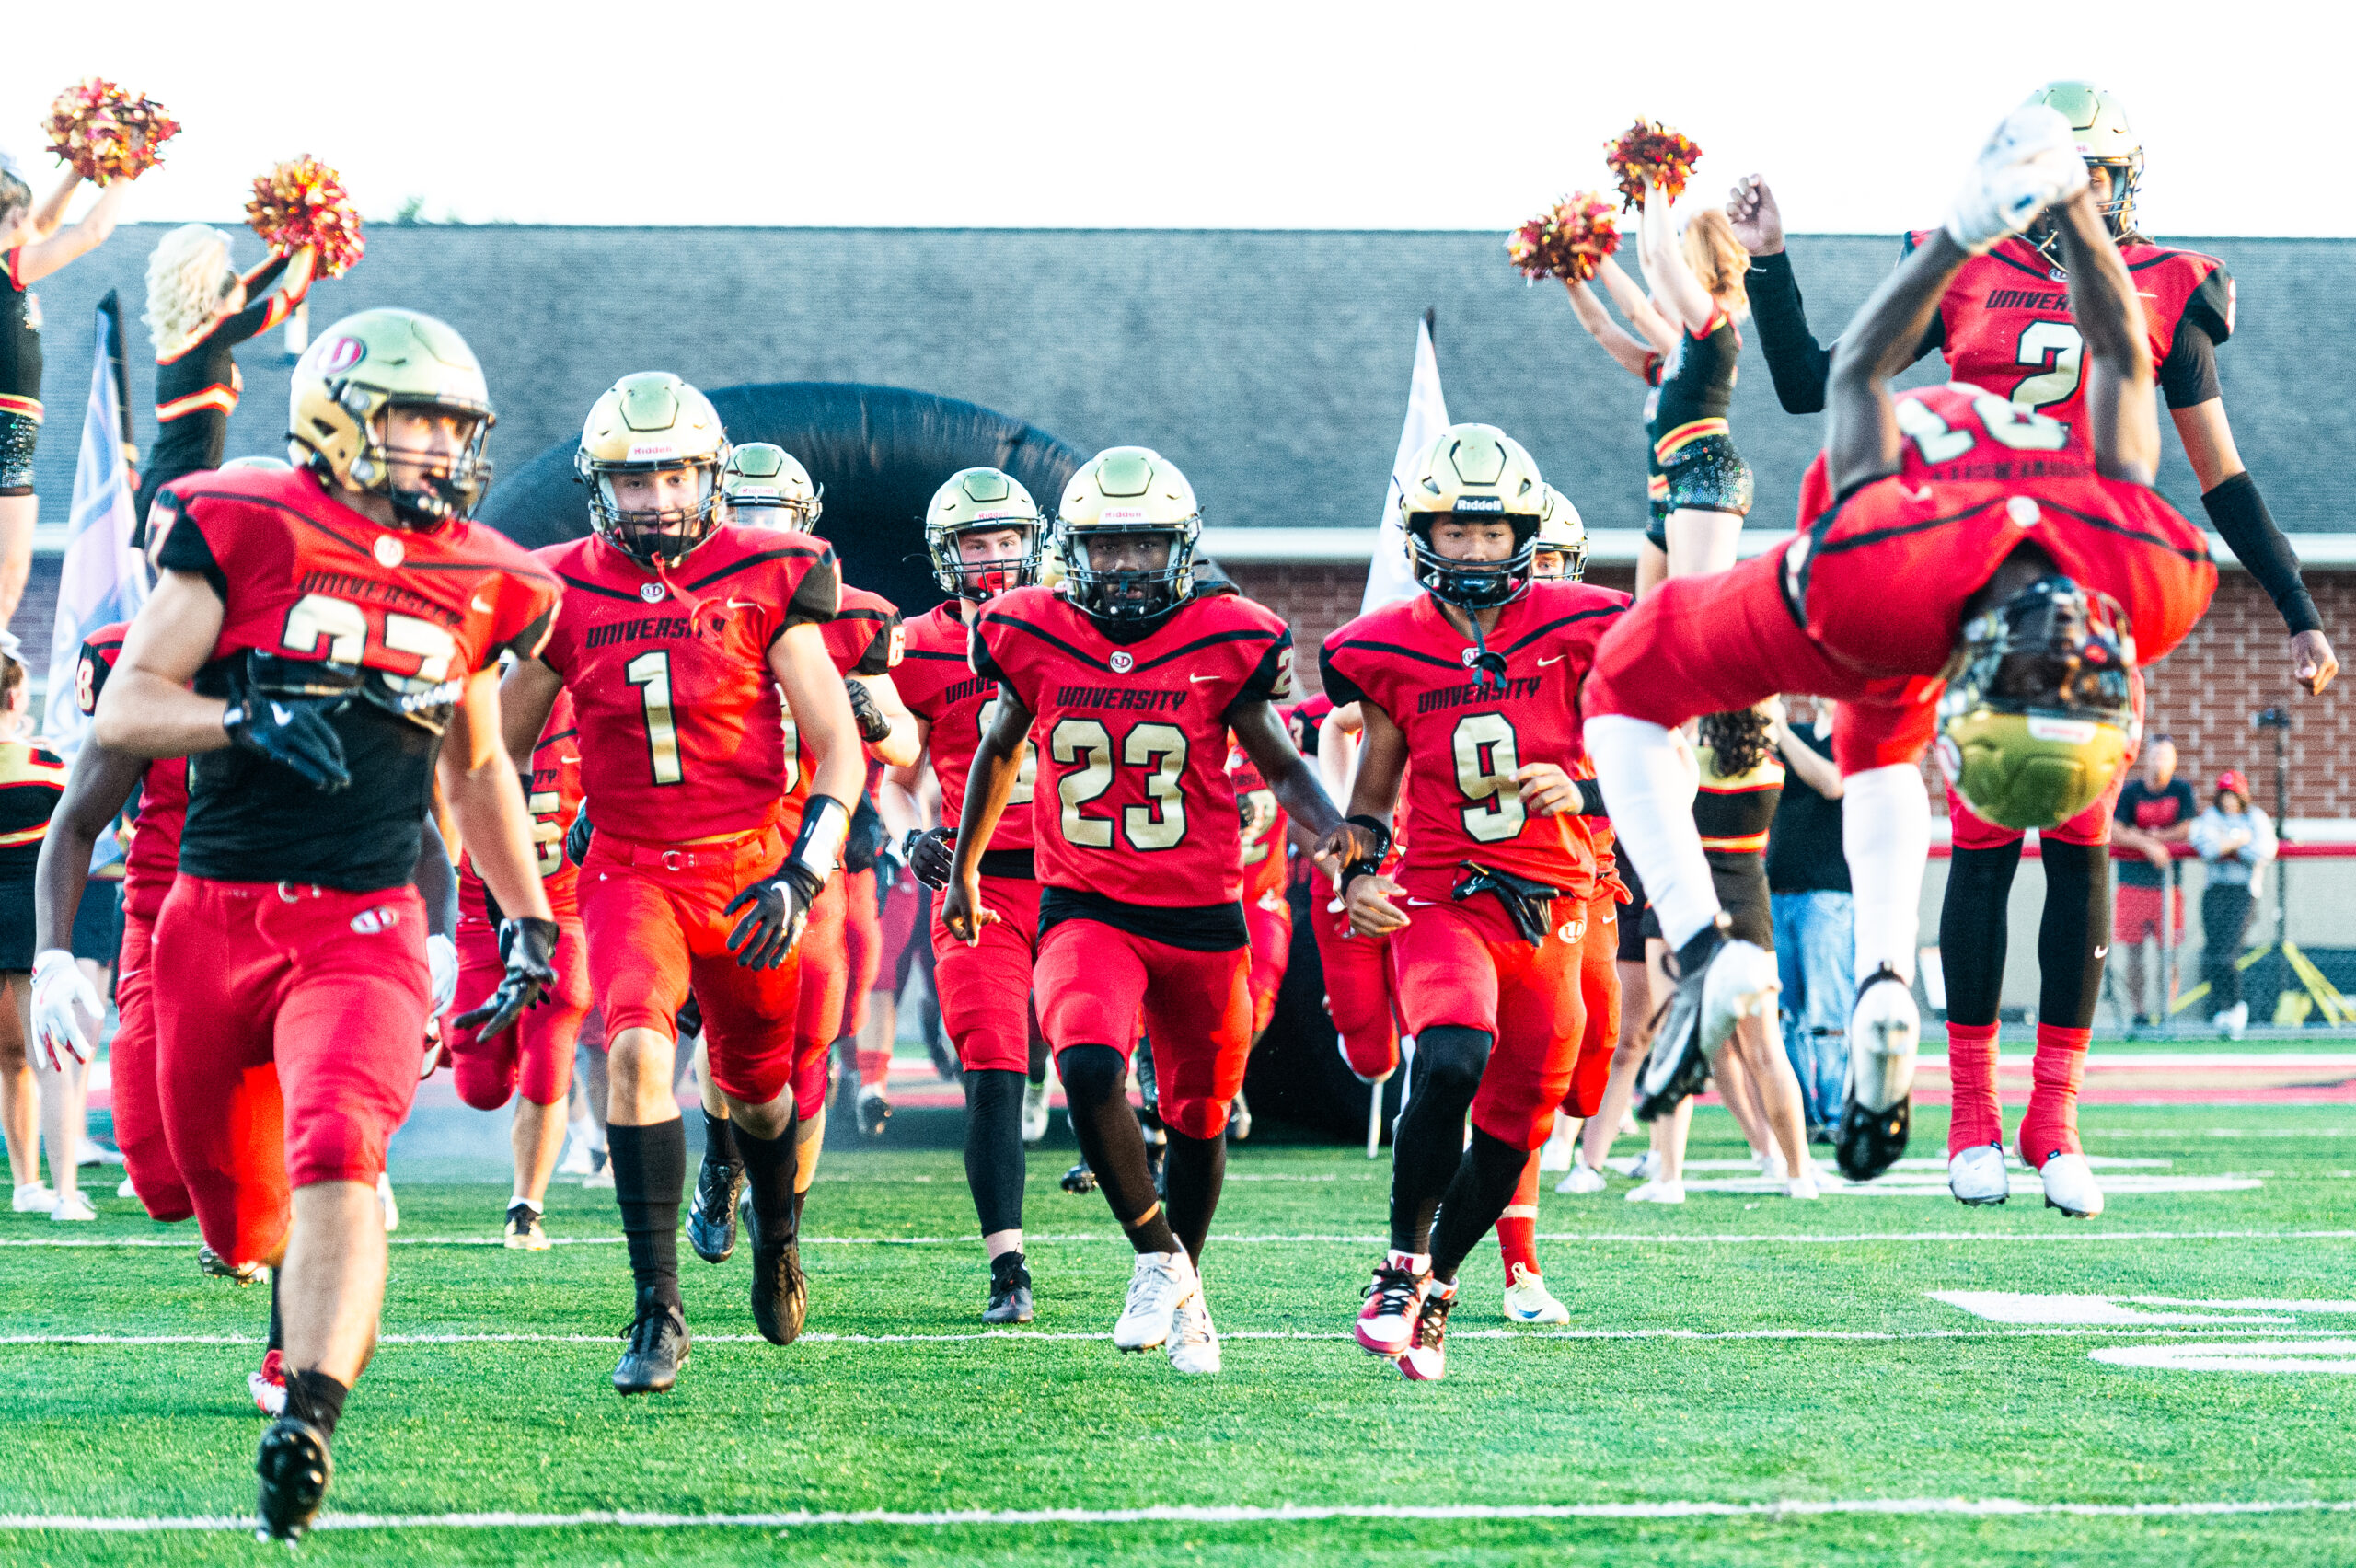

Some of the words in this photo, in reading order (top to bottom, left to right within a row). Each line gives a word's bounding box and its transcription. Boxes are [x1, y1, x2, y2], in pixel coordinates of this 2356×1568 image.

[1986, 289, 2073, 311] UNIVER
[1457, 499, 1502, 511] Riddell
[1055, 686, 1188, 711] UNIVERSITY
[1416, 675, 1542, 715] UNIVERSITY
[625, 648, 685, 787] 1
[1050, 716, 1190, 852] 23
[1450, 709, 1529, 845] 9
